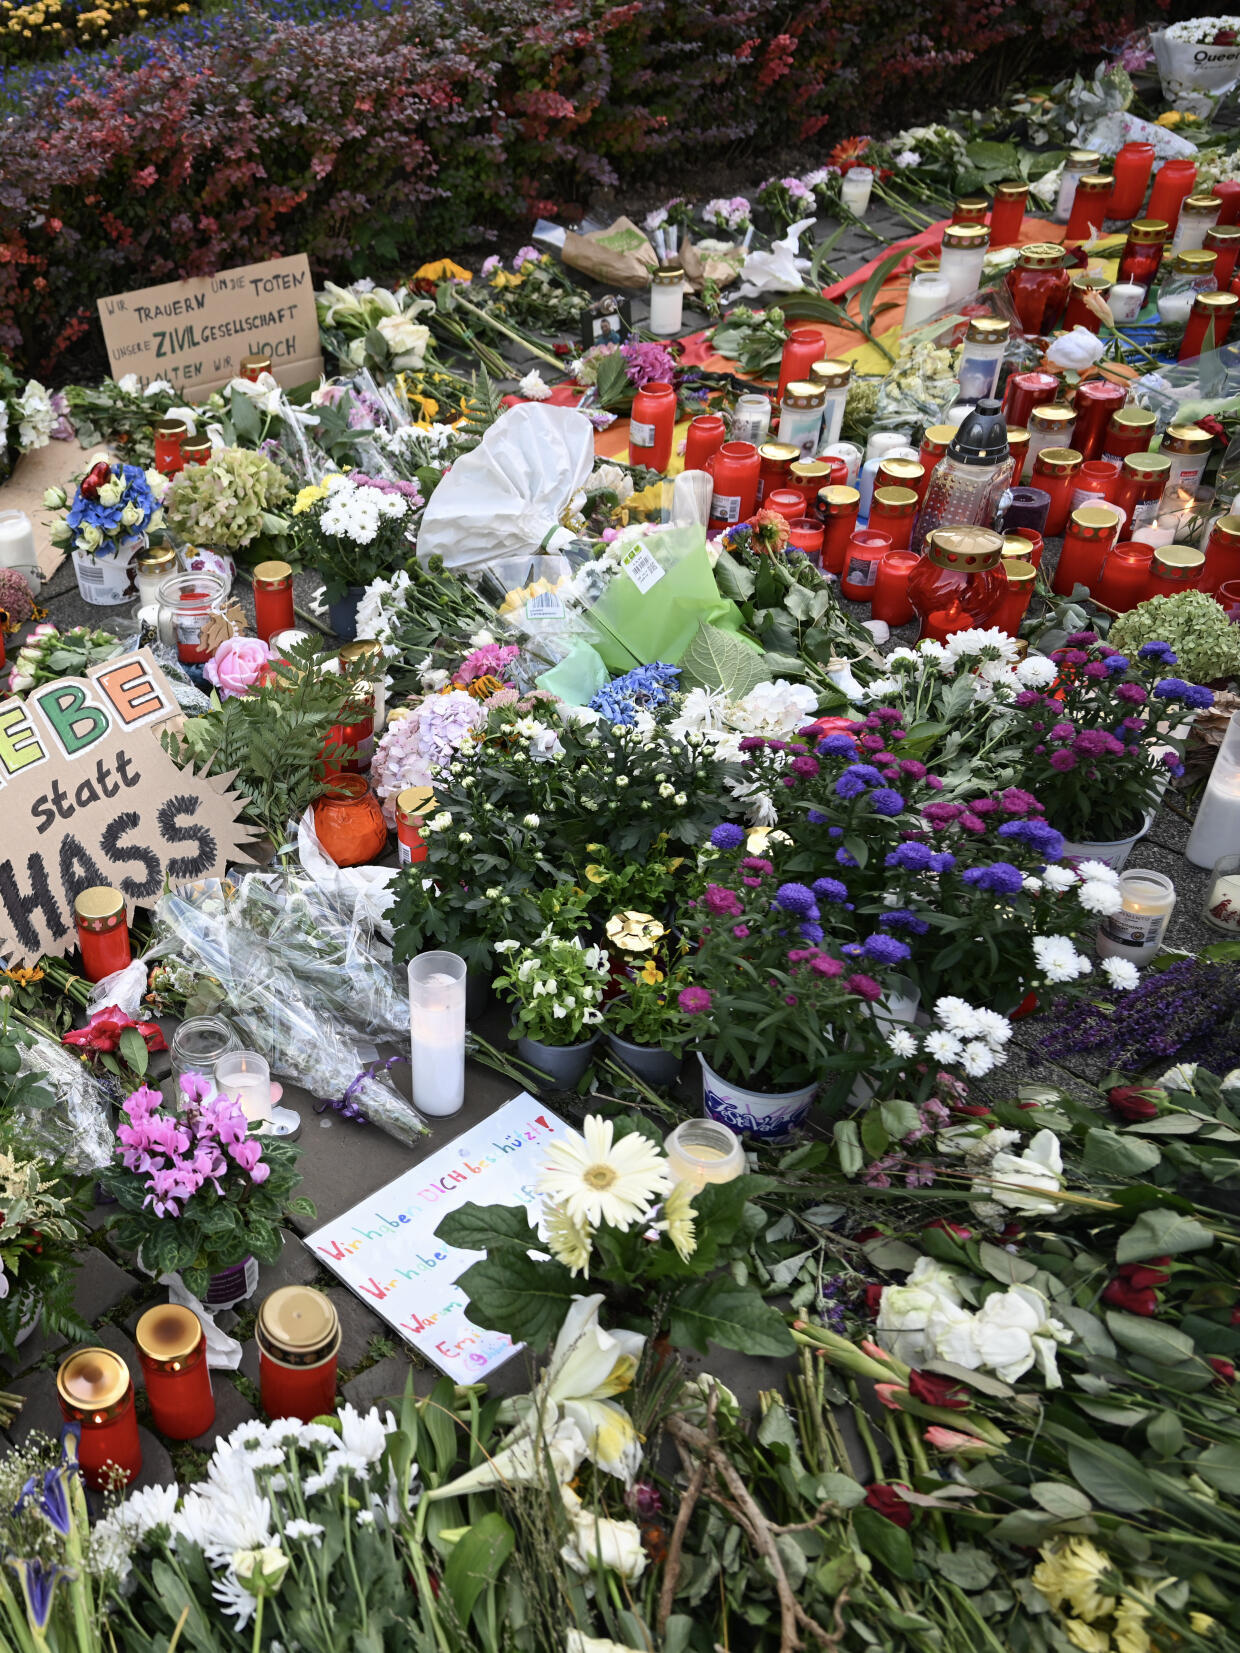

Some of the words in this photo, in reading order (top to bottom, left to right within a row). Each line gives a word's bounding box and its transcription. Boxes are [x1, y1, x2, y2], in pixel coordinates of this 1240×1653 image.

[105, 299, 128, 316] WIR
[133, 293, 205, 323] TRAUERN
[249, 271, 305, 296] TOTEN
[112, 340, 151, 360] UNSERE
[213, 355, 234, 373] WIR
[248, 335, 297, 358] HOCH
[31, 750, 142, 834] statt
[316, 1240, 362, 1261] Wir
[351, 1205, 422, 1241] haben
[399, 1301, 463, 1334] Warum
[434, 1329, 483, 1359] Emi
